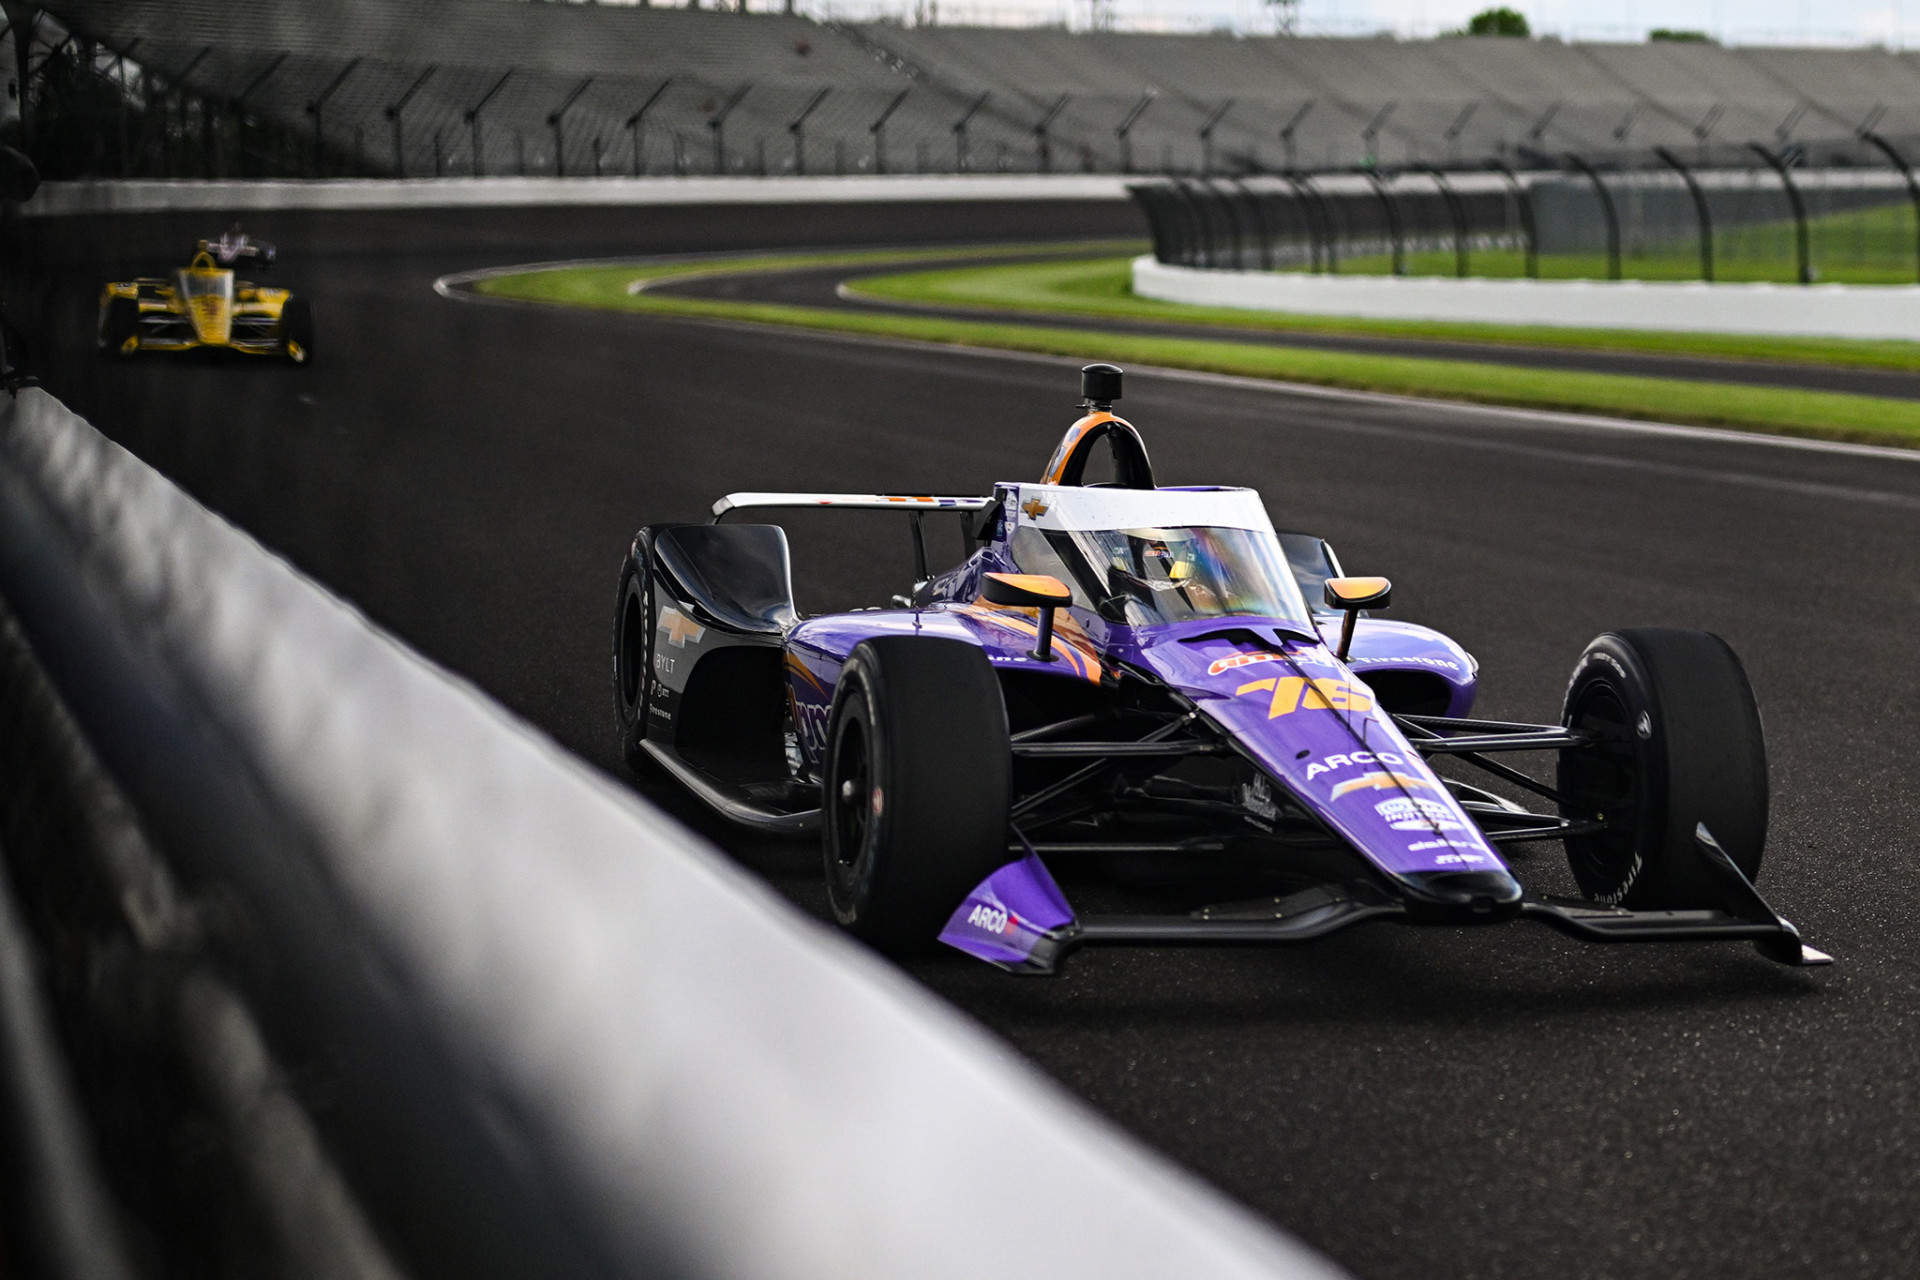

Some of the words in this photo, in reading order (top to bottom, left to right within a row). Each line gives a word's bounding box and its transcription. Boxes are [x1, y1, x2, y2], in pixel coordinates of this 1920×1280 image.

[656, 653, 675, 674] BYLT
[1235, 676, 1373, 720] 76
[1306, 751, 1404, 781] ARCO
[967, 904, 1008, 934] ARCO
